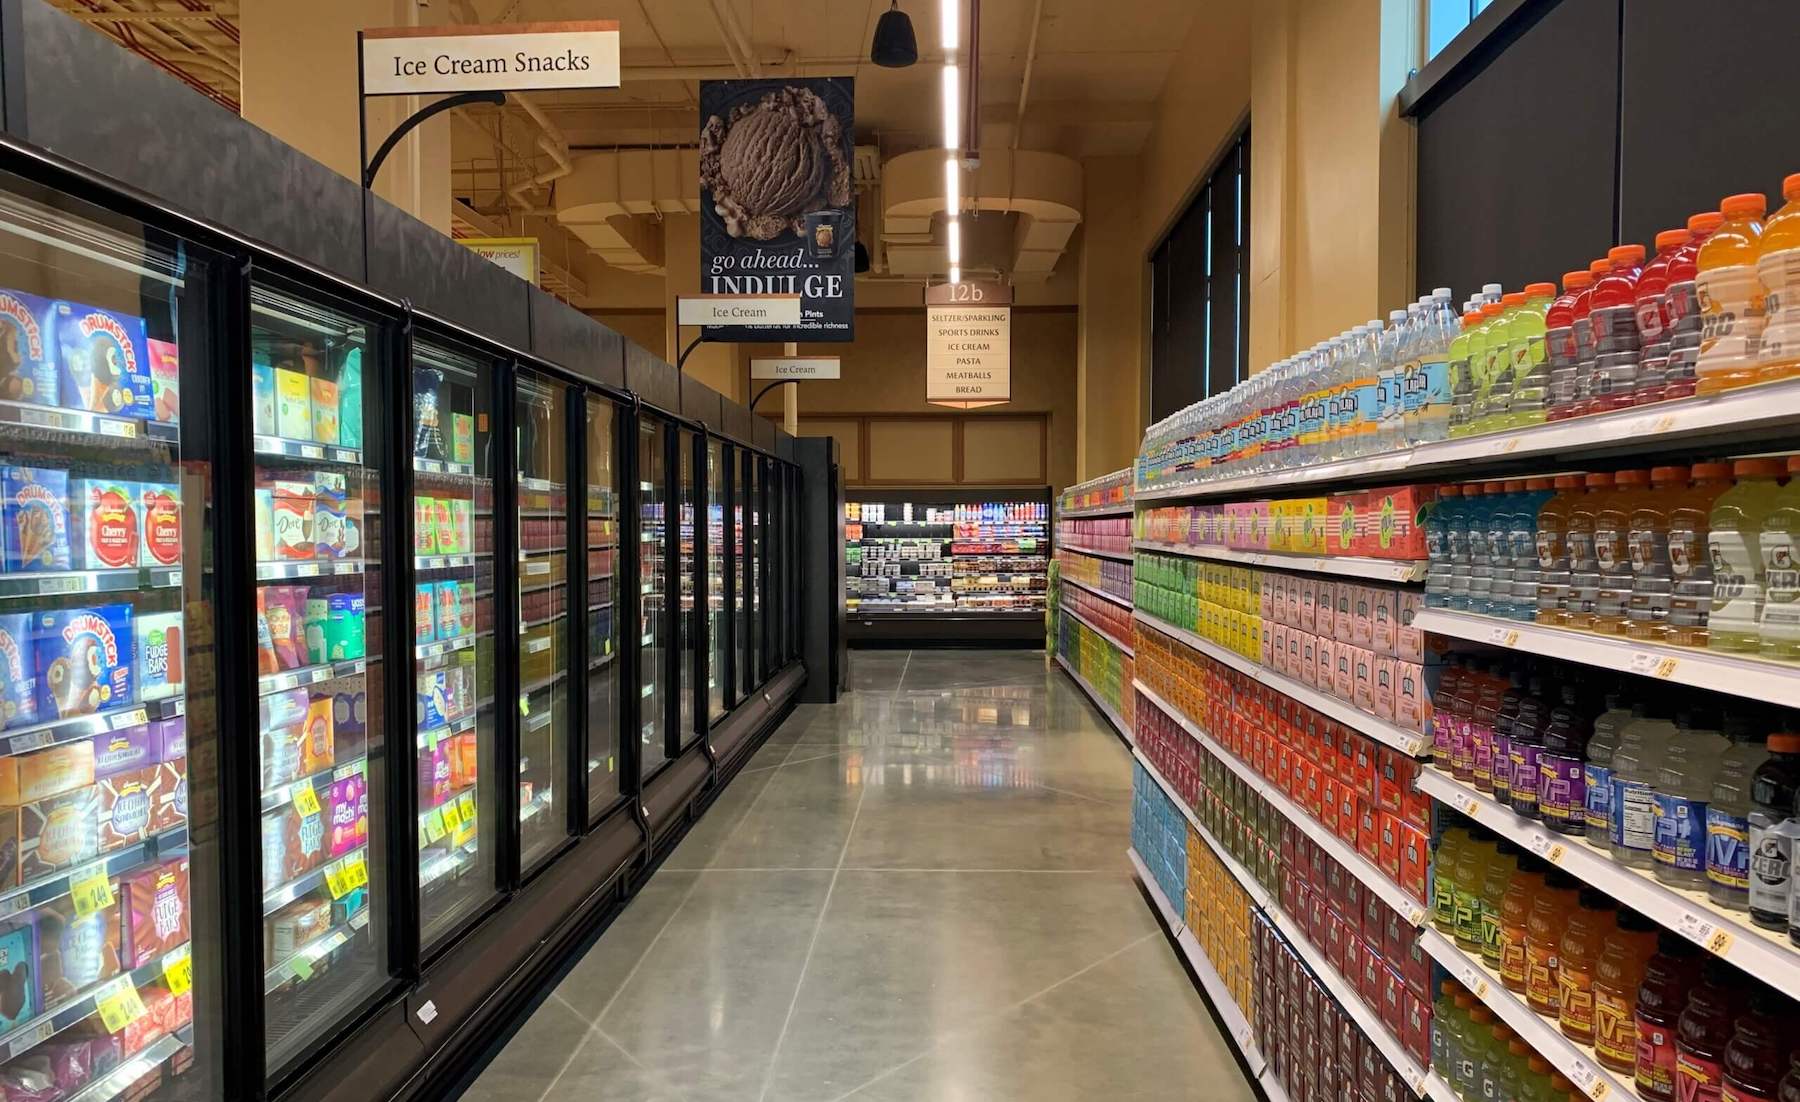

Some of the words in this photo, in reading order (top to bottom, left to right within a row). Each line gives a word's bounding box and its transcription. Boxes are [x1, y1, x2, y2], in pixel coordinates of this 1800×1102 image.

[394, 56, 427, 76] Ice
[434, 54, 508, 75] Cream
[515, 49, 590, 73] Snacks
[711, 255, 735, 274] go
[740, 248, 819, 269] ahead...
[710, 274, 843, 298] INDULGE
[949, 283, 983, 302] 12b
[713, 307, 729, 318] Ice
[732, 307, 767, 318] Cream
[805, 310, 824, 318] Pints
[931, 314, 1006, 323] SELTZER/SPARKLING
[938, 329, 968, 337] SPORTS
[969, 329, 1000, 337] DRINKS
[79, 313, 137, 373] DRUMSTICK
[947, 343, 960, 351] ICE
[961, 343, 991, 351] CREAM
[956, 357, 981, 365] PASTA
[775, 365, 788, 374] Ice
[789, 365, 816, 374] Cream
[946, 372, 992, 380] MEATBALLS
[955, 386, 982, 394] BREAD
[101, 525, 127, 538] Cherry
[156, 526, 177, 538] Cherry
[276, 516, 301, 534] Dove
[62, 615, 118, 668] DRUMSTICK
[145, 645, 168, 660] FUDGE
[148, 658, 168, 674] BARS
[335, 801, 347, 814] my
[333, 807, 355, 825] mochi
[1433, 1030, 1442, 1047] G
[1462, 1061, 1474, 1078] G
[1484, 1079, 1494, 1098] G
